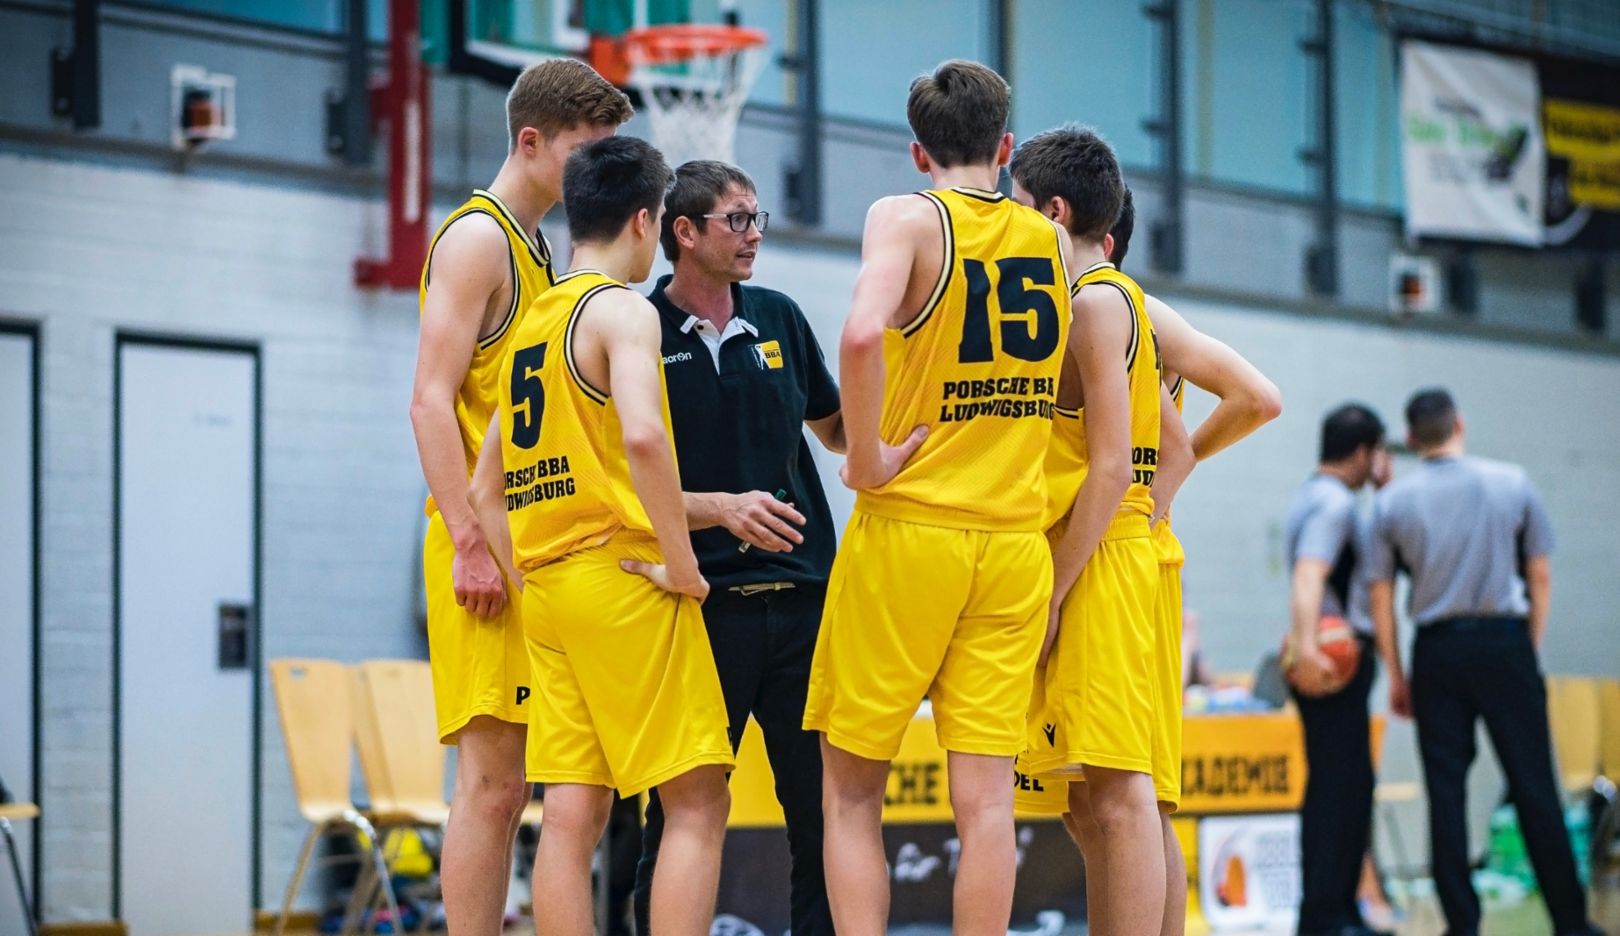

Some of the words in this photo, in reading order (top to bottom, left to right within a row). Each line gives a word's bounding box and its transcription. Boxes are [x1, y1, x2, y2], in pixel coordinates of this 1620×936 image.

[958, 256, 1060, 363] 15
[510, 341, 548, 449] 5
[943, 376, 1030, 400] PORSCHE
[537, 455, 570, 478] BBA
